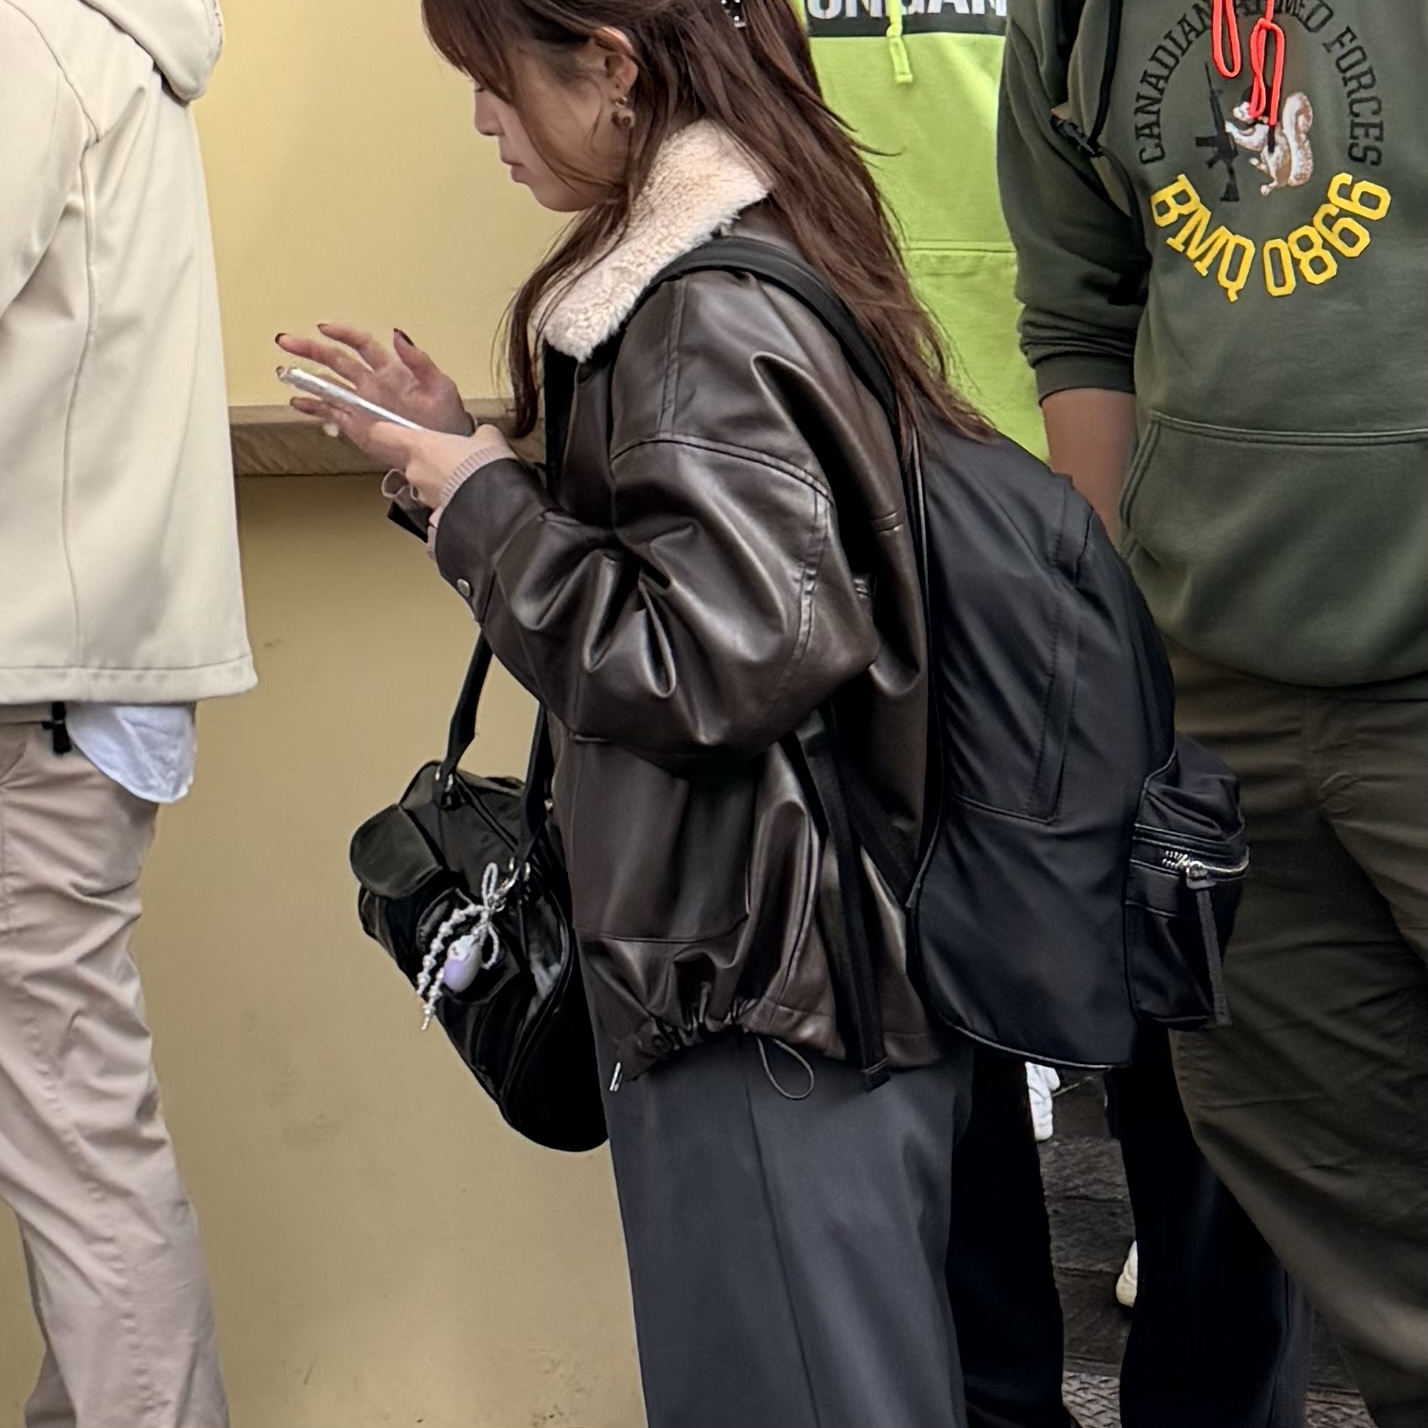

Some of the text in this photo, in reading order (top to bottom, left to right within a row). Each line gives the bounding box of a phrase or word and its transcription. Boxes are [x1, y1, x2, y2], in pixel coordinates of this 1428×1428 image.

[1322, 25, 1385, 168] FORCES
[1150, 172, 1392, 303] BMQ 0866
